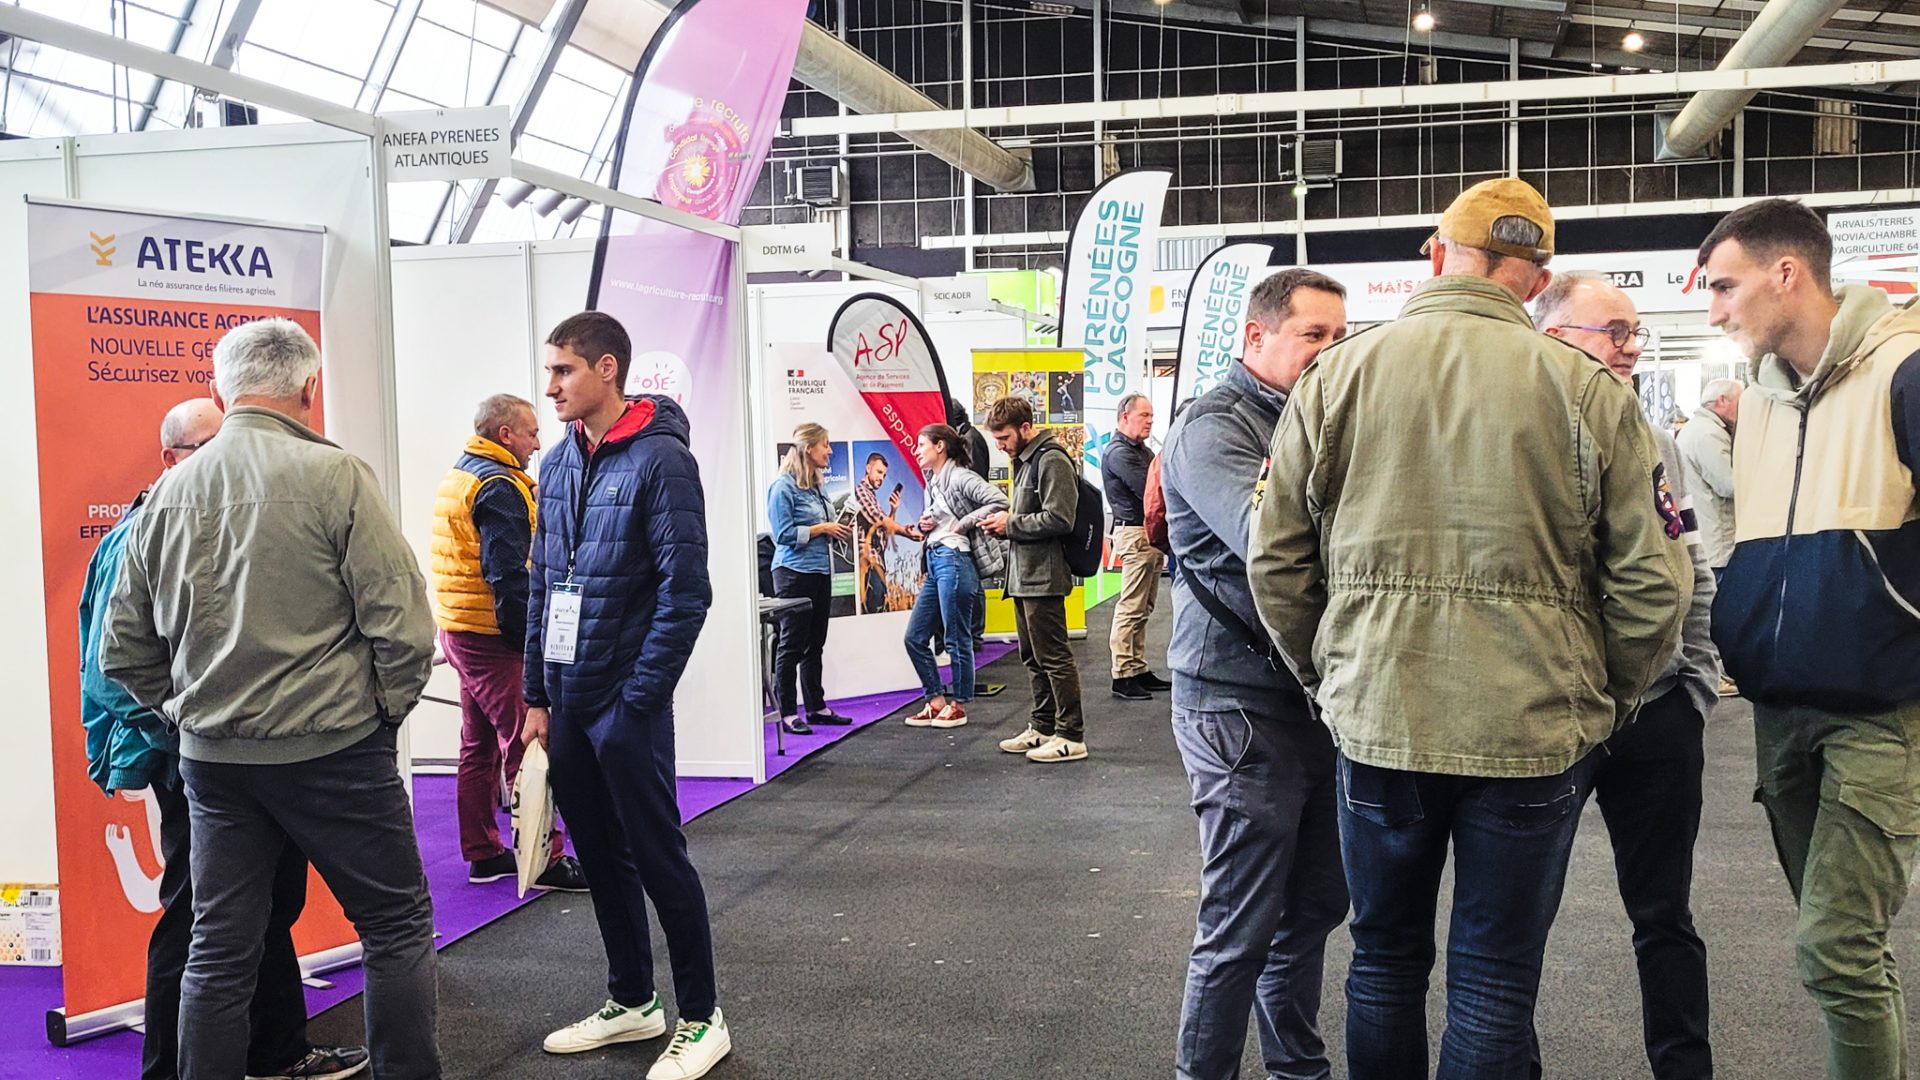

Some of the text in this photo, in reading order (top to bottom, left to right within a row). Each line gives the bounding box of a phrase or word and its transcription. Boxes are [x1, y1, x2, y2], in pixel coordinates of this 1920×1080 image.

[712, 99, 750, 144] recrute
[383, 128, 499, 147] ANEFA PYRENEES
[395, 150, 489, 168] ATLANTIQUES
[1835, 216, 1914, 229] ARVALIS/TERRES
[137, 236, 274, 279] ATEKKA
[763, 245, 805, 255] DDTM 64
[1907, 242, 1919, 251] 64
[138, 279, 276, 296] La néo assurance des filières agricoles
[1668, 265, 1711, 294] Le Sil
[934, 291, 971, 300] SCIC ADER
[1083, 200, 1119, 393] PYRÉNÉES
[1105, 201, 1144, 397] GASCOGNE
[87, 306, 209, 330] L'ASSURANCE
[1214, 264, 1249, 382] ASCOGNE
[90, 337, 217, 361] NOUVELLE GÉ
[854, 319, 908, 368] ASP
[88, 361, 215, 383] Sécurisez vos
[788, 379, 826, 387] RÉPUBLIQUE
[80, 524, 112, 539] EFF
